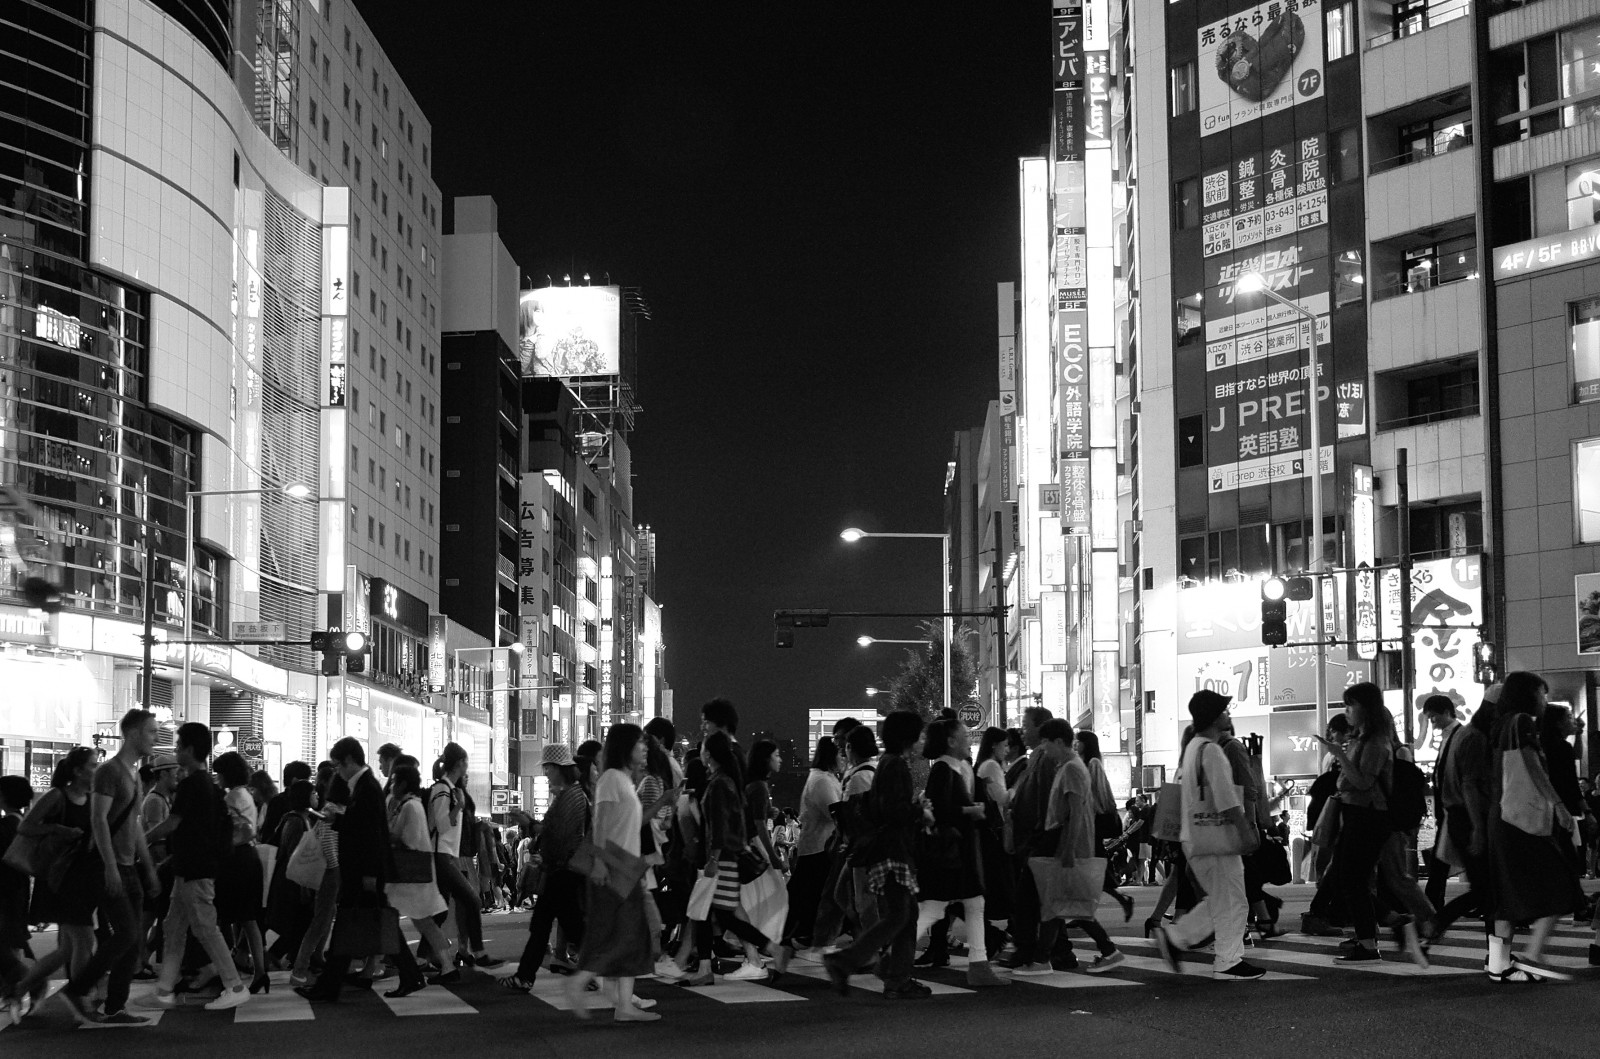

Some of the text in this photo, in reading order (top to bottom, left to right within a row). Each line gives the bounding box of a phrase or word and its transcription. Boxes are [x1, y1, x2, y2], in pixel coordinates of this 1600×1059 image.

[1058, 21, 1079, 77] アビバ
[1301, 74, 1317, 92] 7F
[1086, 93, 1107, 139] Luxy
[1238, 137, 1319, 180] 鍼灸院
[1205, 173, 1227, 191] 渋谷
[1239, 160, 1320, 201] 整骨院
[1205, 187, 1227, 204] 駅前
[1246, 195, 1327, 228] 予約 03-6434-1254
[1300, 212, 1320, 227] 検索
[1204, 223, 1230, 235] 入口この下
[1266, 224, 1282, 236] 渋谷
[1215, 238, 1231, 252] 6階
[1218, 246, 1303, 285] 近畿日本
[1218, 266, 1314, 304] ツリスト
[1064, 302, 1081, 310] 5F
[1063, 323, 1083, 383] ECC
[1207, 342, 1233, 355] 入口この下
[1240, 333, 1295, 356] 渋谷営業所
[1065, 385, 1083, 449] 外語学院
[1209, 385, 1330, 432] J PREP
[1239, 426, 1299, 459] 英語塾
[1258, 464, 1286, 478] 渋谷校
[1354, 469, 1371, 492] 1F
[1064, 465, 1072, 523] カラダファクトリー
[1455, 557, 1479, 582] 1F
[625, 587, 633, 642] ホールディングス
[1323, 580, 1334, 631] 右車専用
[237, 624, 280, 633] 宮益坂下
[1232, 660, 1253, 702] 7
[1346, 671, 1363, 686] 2F
[960, 711, 981, 721] 消火栓
[245, 742, 262, 751] 消火栓
